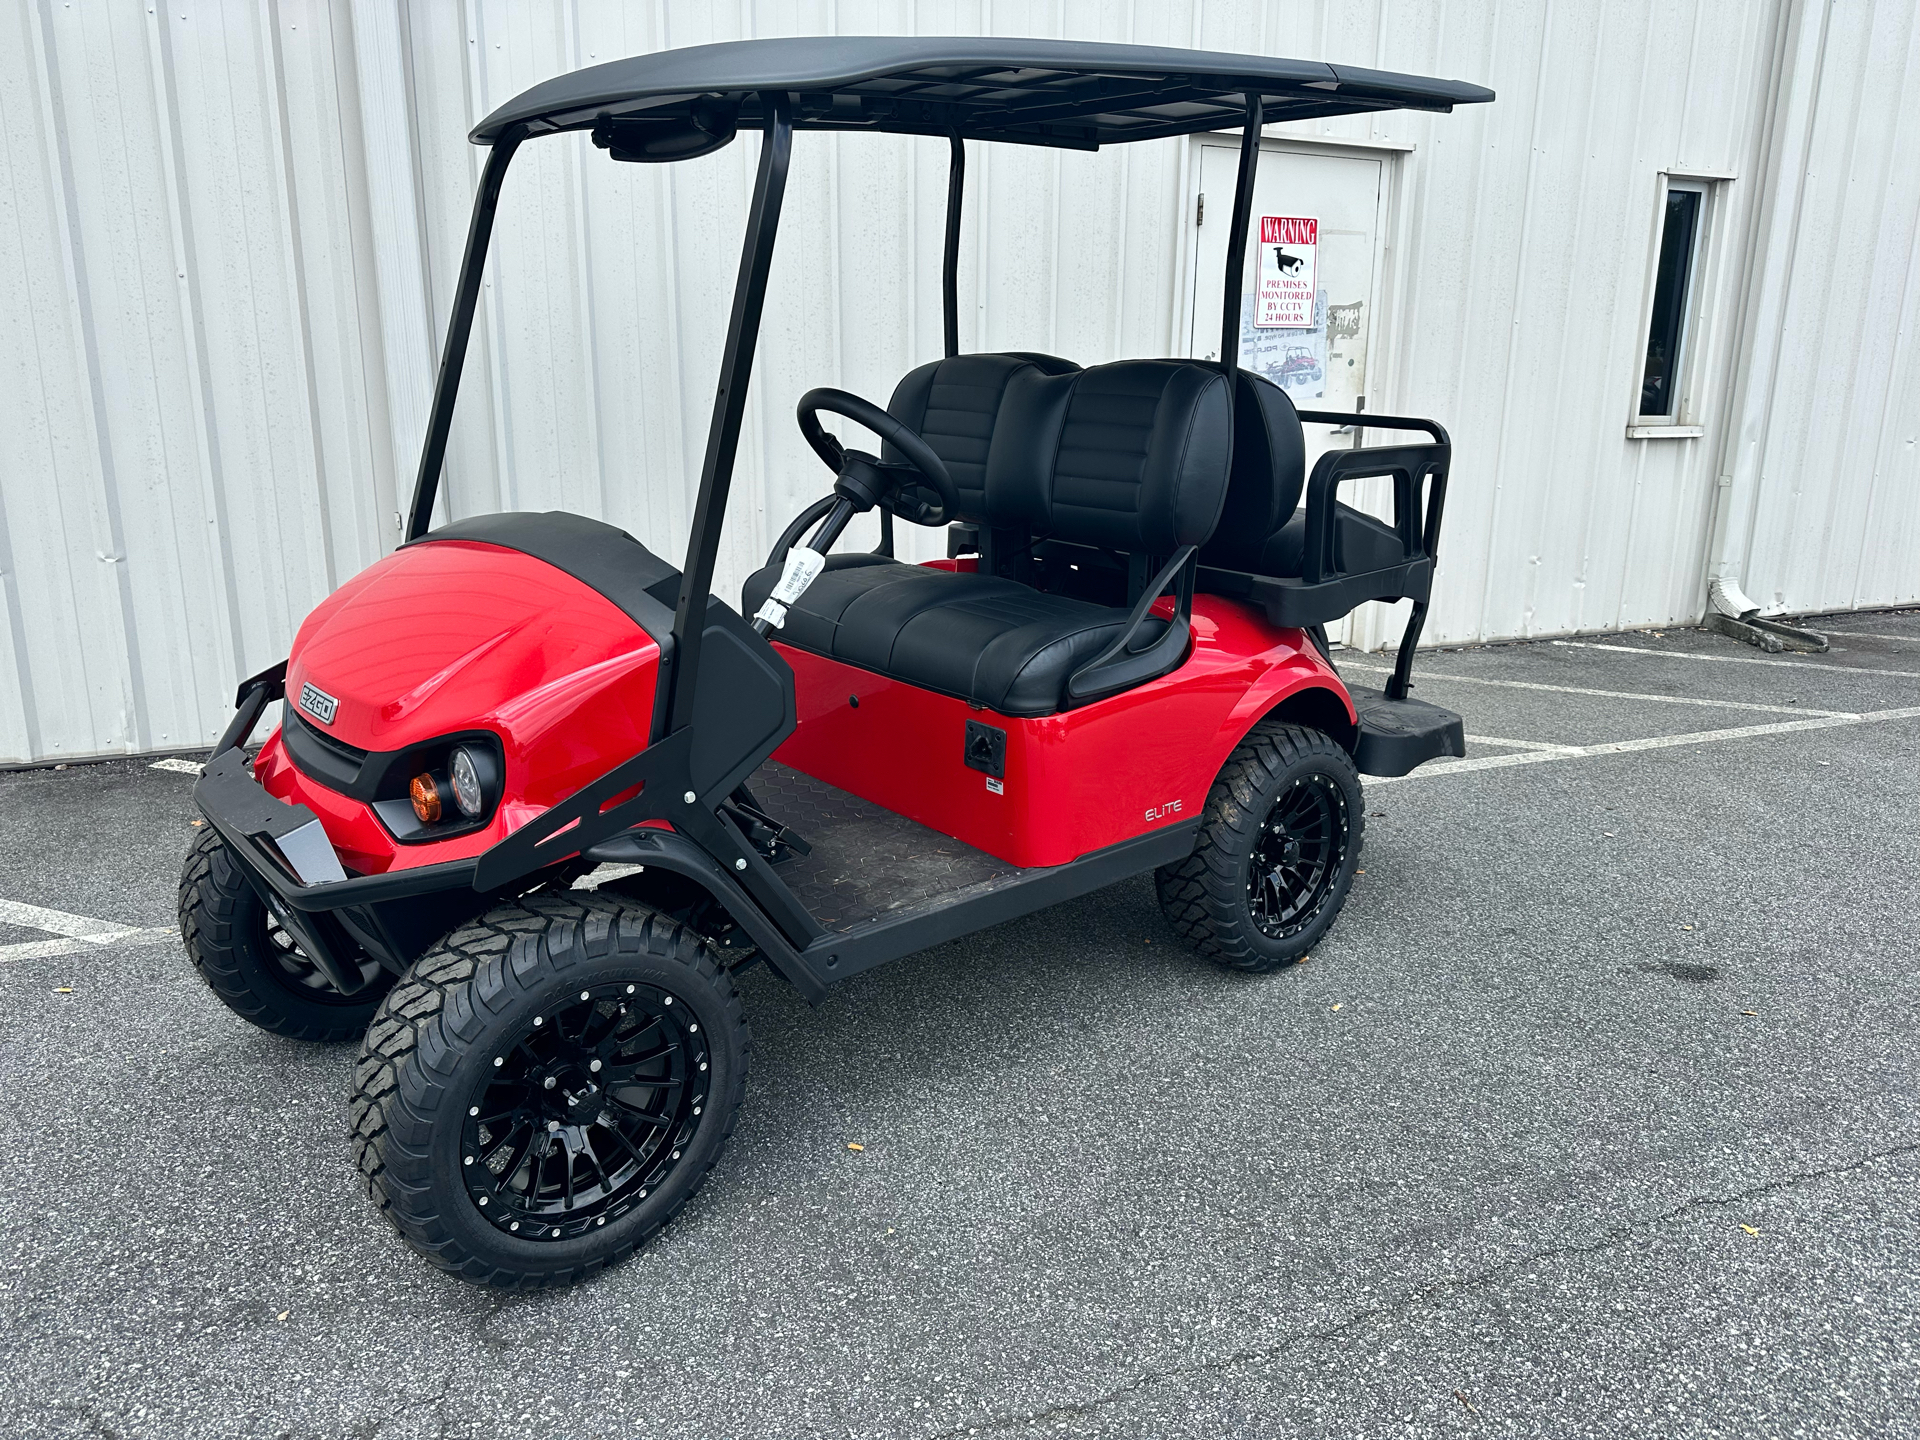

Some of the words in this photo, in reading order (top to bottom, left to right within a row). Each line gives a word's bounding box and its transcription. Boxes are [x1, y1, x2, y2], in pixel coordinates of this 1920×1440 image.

[1263, 217, 1316, 245] WARNING
[1266, 280, 1308, 289] PREMISES
[1261, 290, 1312, 300] MONITORED
[1267, 302, 1278, 311] BY
[1280, 302, 1304, 311] CCTV
[1265, 313, 1273, 321] 24
[1275, 313, 1304, 322] HOURS
[300, 685, 333, 721] EZGO
